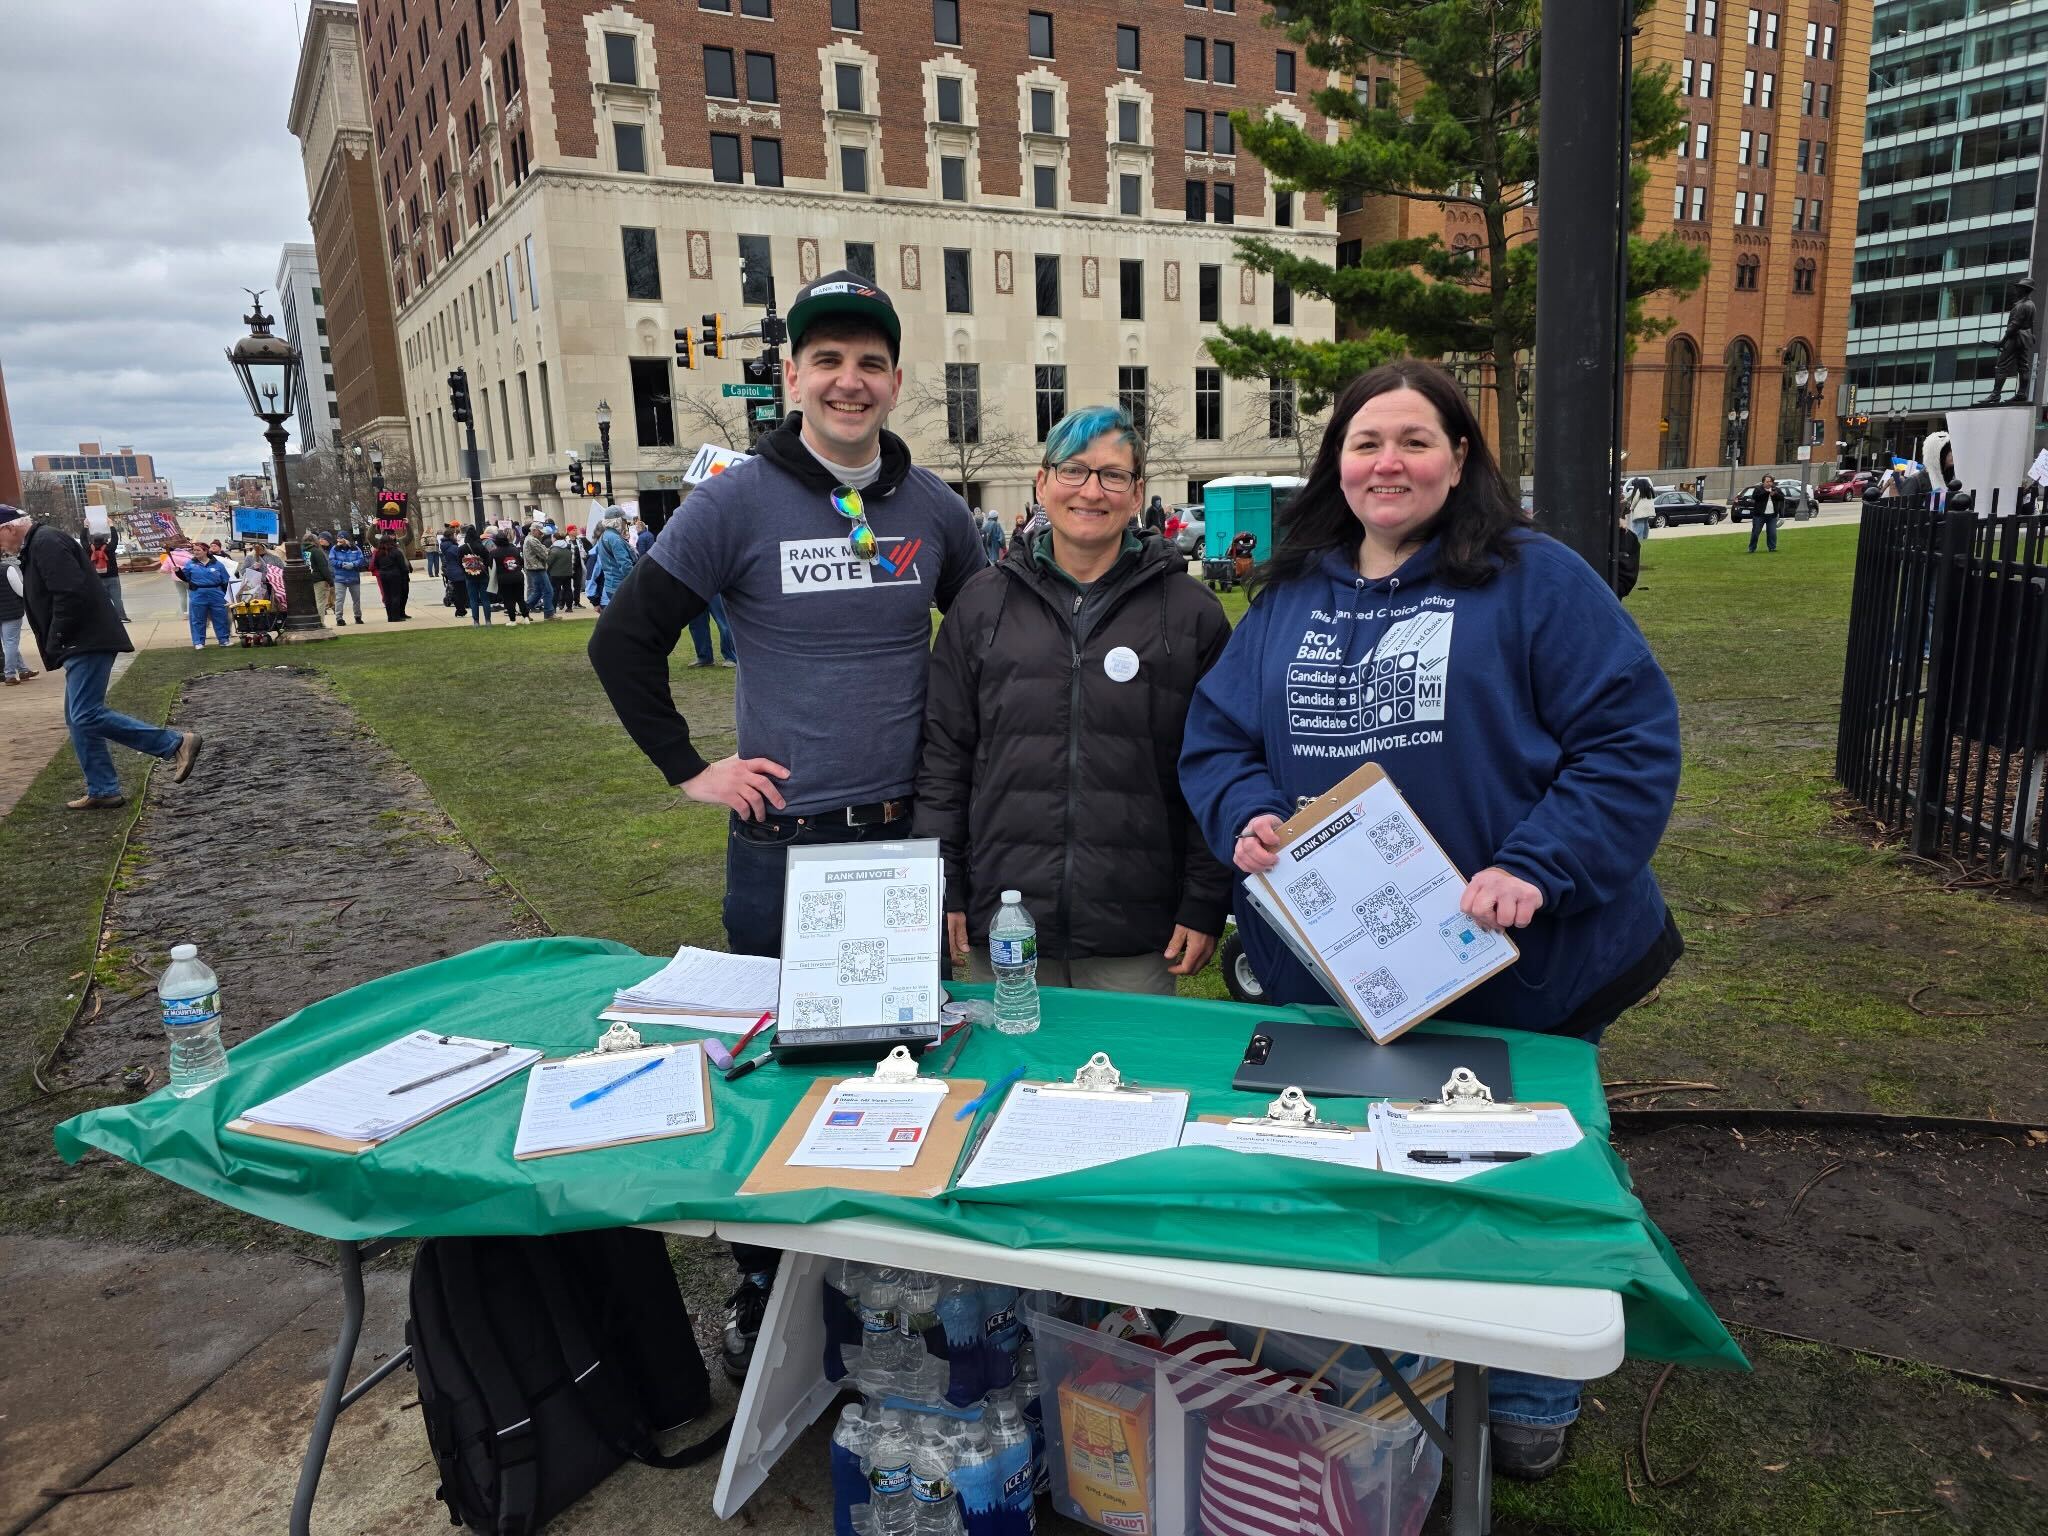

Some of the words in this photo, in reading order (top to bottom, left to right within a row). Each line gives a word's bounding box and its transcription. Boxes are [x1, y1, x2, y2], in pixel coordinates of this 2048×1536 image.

[730, 384, 760, 397] Capitol
[378, 491, 407, 501] FREE
[789, 546, 837, 560] RANK
[790, 561, 863, 584] VOTE
[1332, 609, 1374, 625] Raned
[1420, 595, 1456, 608] Voting
[1423, 617, 1443, 636] Choice
[1302, 630, 1338, 646] RCV
[1296, 645, 1343, 661] Ballot
[1290, 669, 1347, 684] Candidate
[1348, 671, 1358, 684] A
[1418, 674, 1442, 683] RANK
[1418, 683, 1442, 698] MI
[1290, 691, 1347, 706] Candidae
[1349, 693, 1357, 706] B
[1418, 699, 1442, 709] VOTE
[1291, 714, 1348, 729] Candidate
[1349, 714, 1359, 728] C
[1293, 837, 1320, 860] RANK
[1317, 829, 1331, 843] MI
[1329, 814, 1353, 834] VOTE
[827, 871, 854, 882] RANK
[856, 871, 868, 880] MI
[869, 869, 894, 879] VOTE
[986, 1313, 1005, 1331] ICE
[1005, 1473, 1021, 1493] ICE
[1105, 1516, 1144, 1533] Lance
